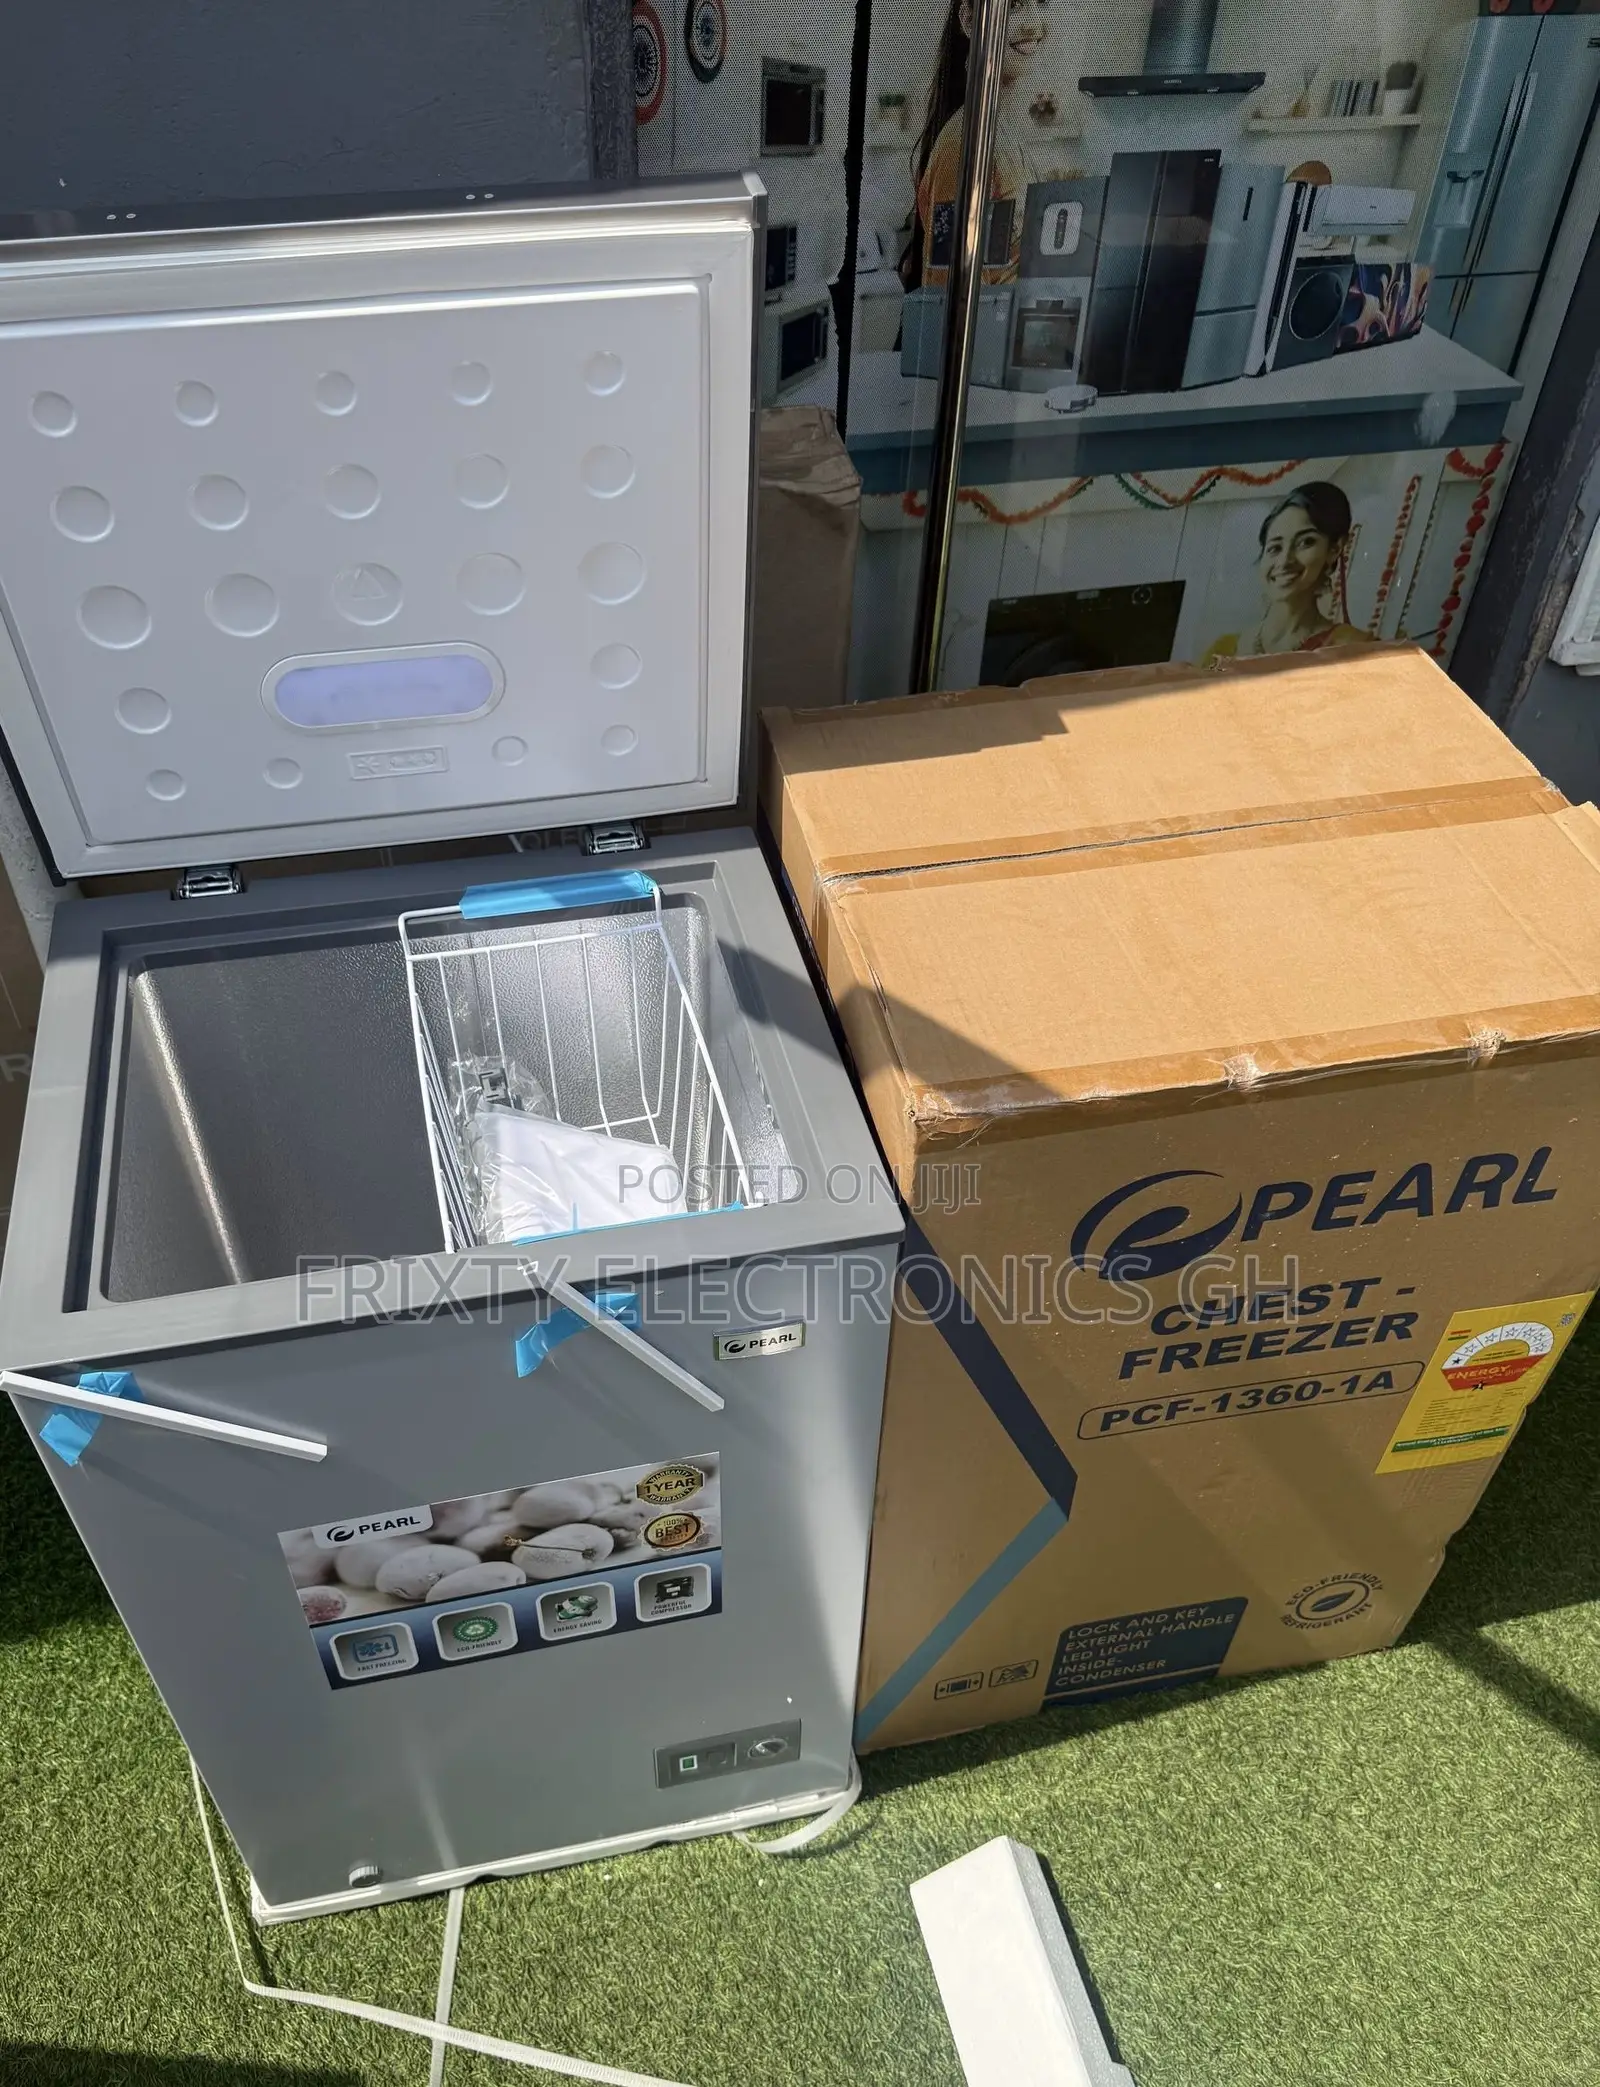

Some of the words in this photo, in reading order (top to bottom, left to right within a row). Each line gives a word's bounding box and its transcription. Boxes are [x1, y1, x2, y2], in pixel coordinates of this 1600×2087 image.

[1240, 1146, 1558, 1242] PEARL
[1151, 1277, 1382, 1336] CHEST
[749, 1333, 797, 1349] PEARL
[1118, 1312, 1419, 1380] FREEZER
[1447, 1365, 1511, 1379] ENERGY
[1100, 1370, 1395, 1432] PCF-1360-1A
[654, 1478, 695, 1492] YEAR
[359, 1516, 421, 1534] PEARL
[656, 1523, 691, 1538] BEST
[1284, 1572, 1383, 1606] ECO-FRIENDLY
[553, 1624, 578, 1634] ENERGY
[1065, 1627, 1154, 1651] EXTERNAL
[1161, 1613, 1236, 1633] HANDLE
[1068, 1622, 1120, 1640] LOCK
[1128, 1612, 1169, 1629] AND
[1174, 1606, 1209, 1620] KEY
[1062, 1649, 1094, 1664] LED
[1099, 1639, 1152, 1657] LIGHT
[1055, 1658, 1167, 1687] CONDENSER
